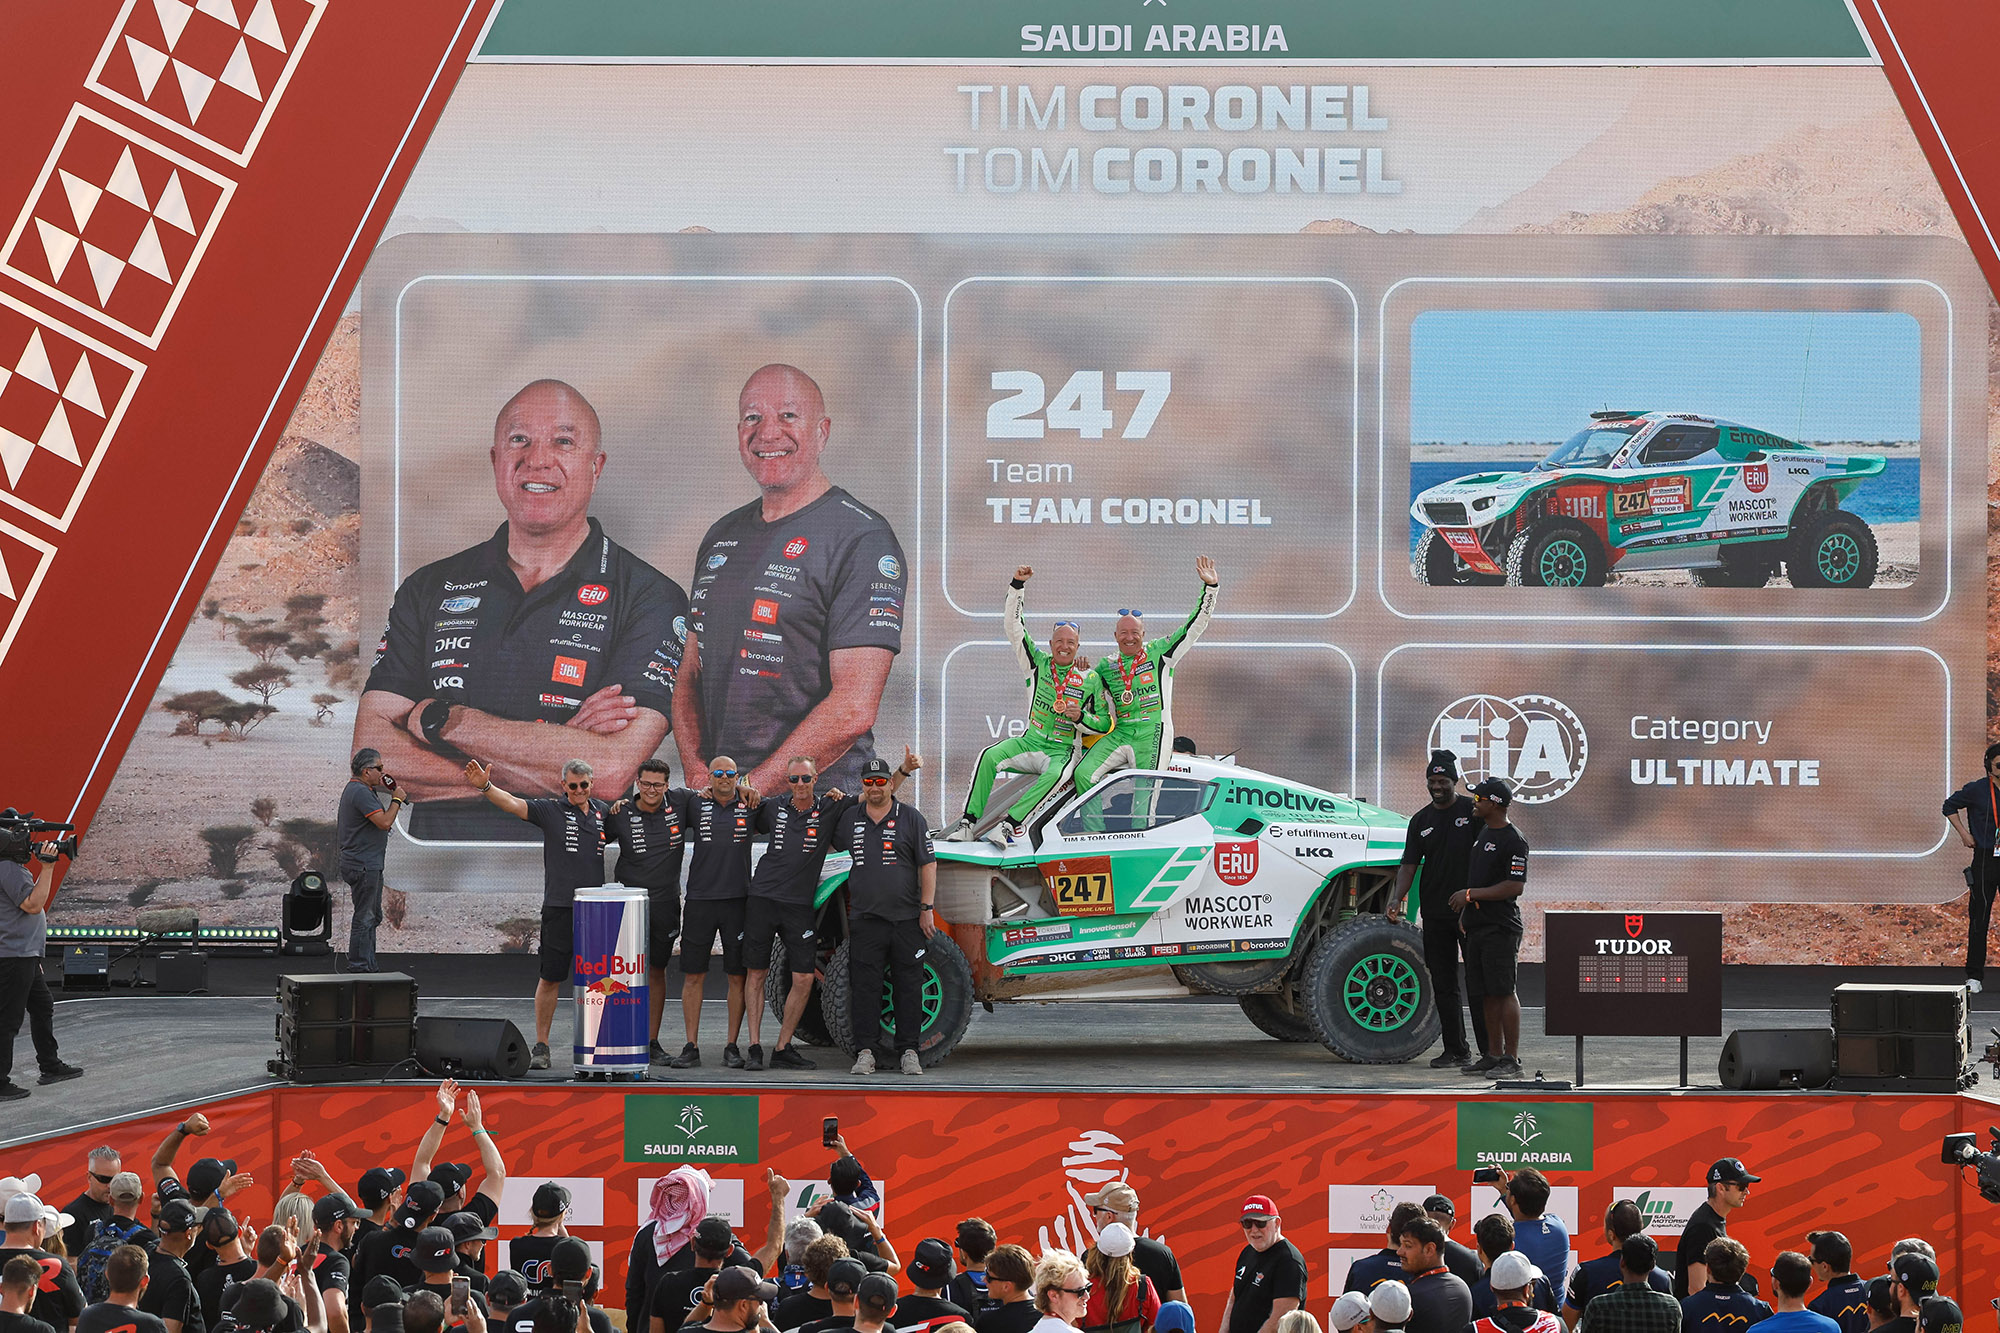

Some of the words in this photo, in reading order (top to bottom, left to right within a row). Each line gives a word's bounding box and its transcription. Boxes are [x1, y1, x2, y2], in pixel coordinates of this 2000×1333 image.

[1021, 24, 1132, 52] SAUDI
[1143, 24, 1289, 52] ARABIA
[957, 84, 1067, 131] TIM
[1078, 84, 1389, 132] CORONEL
[943, 147, 1080, 193] TOM
[1092, 147, 1400, 193] CORONEL
[986, 370, 1172, 439] 247
[1728, 426, 1794, 450] Emotive
[986, 459, 1073, 483] Team
[1746, 471, 1766, 486] ERU
[1565, 495, 1604, 519] JBL
[1618, 492, 1647, 512] 247
[1653, 496, 1680, 504] MOTUL
[986, 498, 1092, 524] TEAM
[1100, 498, 1272, 525] CORONEL
[1728, 510, 1778, 522] WORKWEAR
[786, 542, 806, 555] ERU
[580, 588, 607, 601] ERU
[757, 605, 773, 619] JBL
[558, 619, 605, 632] WORKWEAR
[434, 636, 472, 653] DHG
[559, 663, 580, 679] JBL
[433, 676, 465, 690] LKQ
[1630, 715, 1773, 746] Category
[1630, 759, 1820, 787] ULTIMATE
[1286, 828, 1365, 841] efulfilment.eu
[1295, 847, 1334, 858] LKQ
[1218, 853, 1254, 874] ERU
[1057, 875, 1107, 902] 247
[1079, 921, 1136, 934] Innovationsoft
[1184, 914, 1273, 930] WORKWEAR
[1005, 926, 1038, 942] BS
[1006, 933, 1069, 947] INTERNATIONAL
[1595, 939, 1673, 955] TUDOR
[576, 954, 608, 975] Red
[611, 954, 646, 975] Bull
[1049, 952, 1076, 962] DHG
[613, 997, 641, 1005] DRINK
[644, 1144, 684, 1155] SAUDI
[687, 1145, 738, 1156] ARABIA
[1476, 1152, 1518, 1163] SAUDI
[1521, 1152, 1573, 1164] ARABIA
[1243, 1203, 1264, 1211] MOTUL
